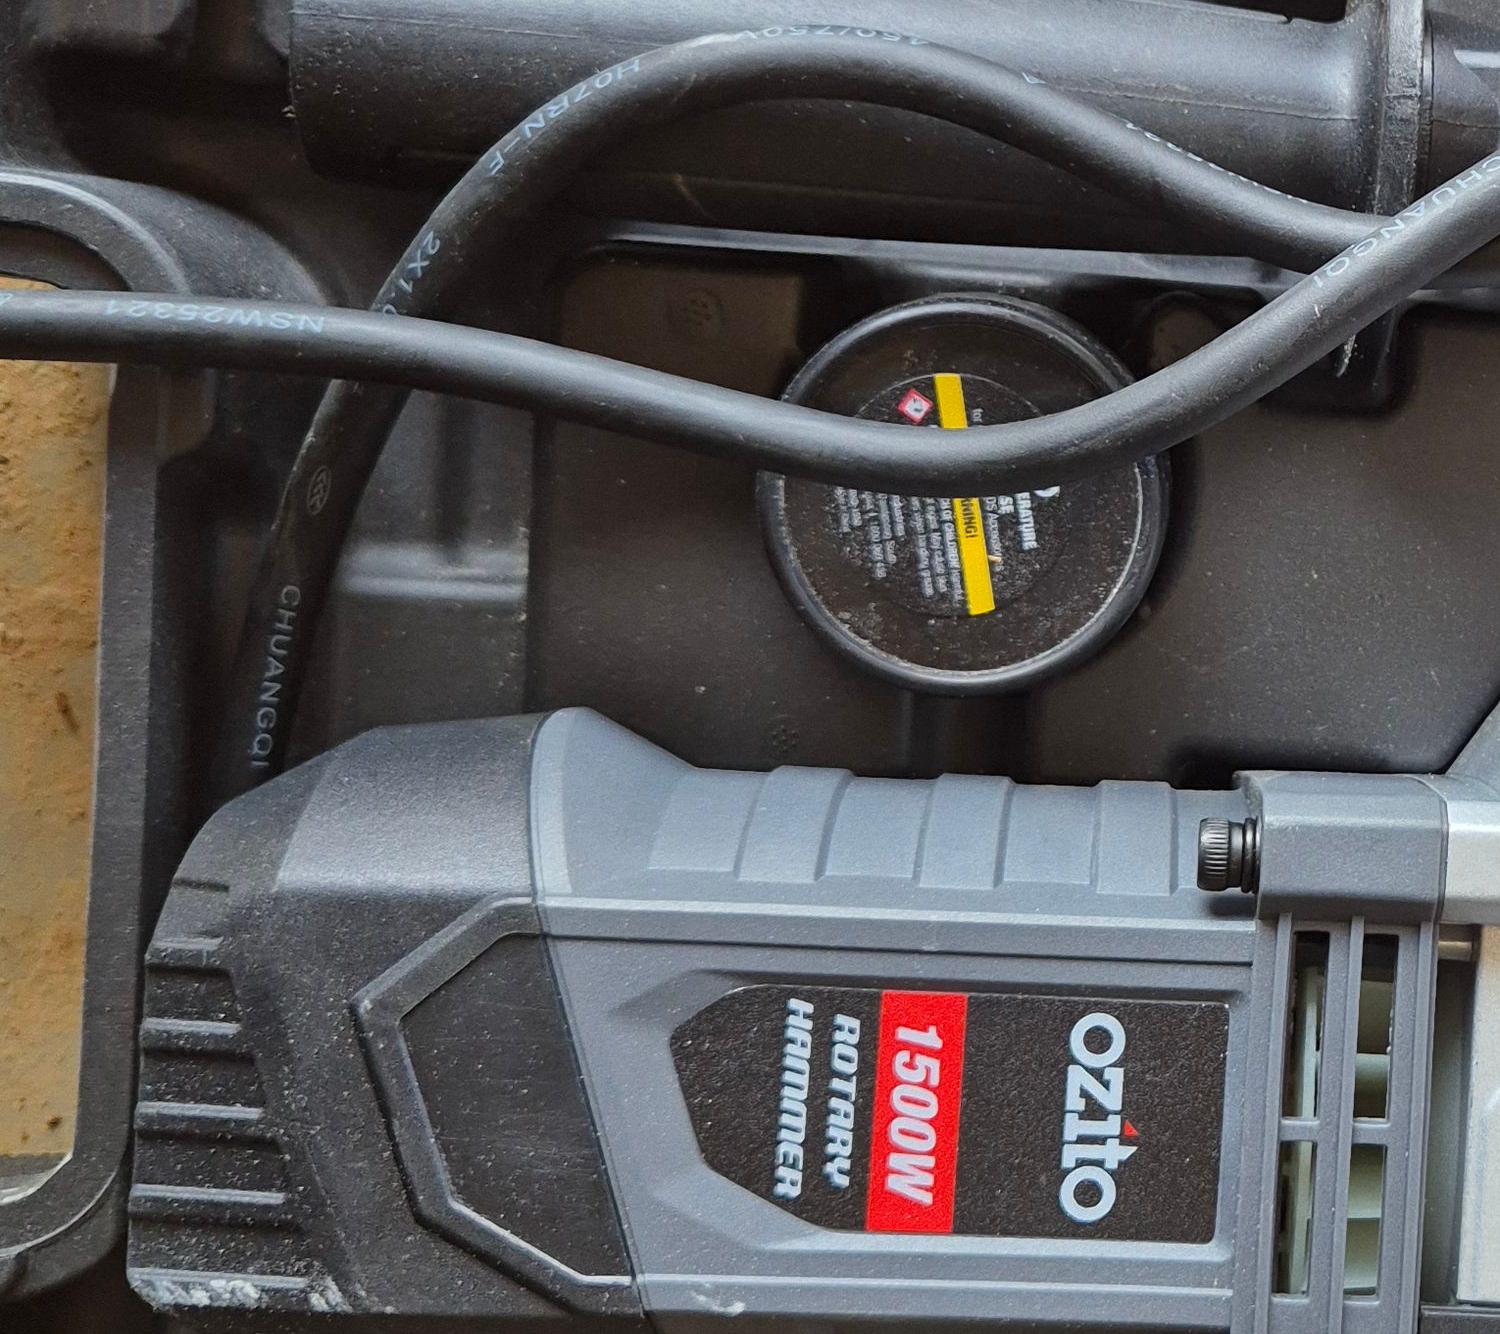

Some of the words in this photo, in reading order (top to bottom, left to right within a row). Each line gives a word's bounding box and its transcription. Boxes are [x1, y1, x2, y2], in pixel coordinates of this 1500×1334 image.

[482, 56, 641, 176] H07RN-F
[247, 584, 303, 769] CHUANGQI
[772, 997, 816, 1200] HAMMER
[820, 1013, 863, 1189] ROTARY
[883, 1023, 944, 1207] 1500W
